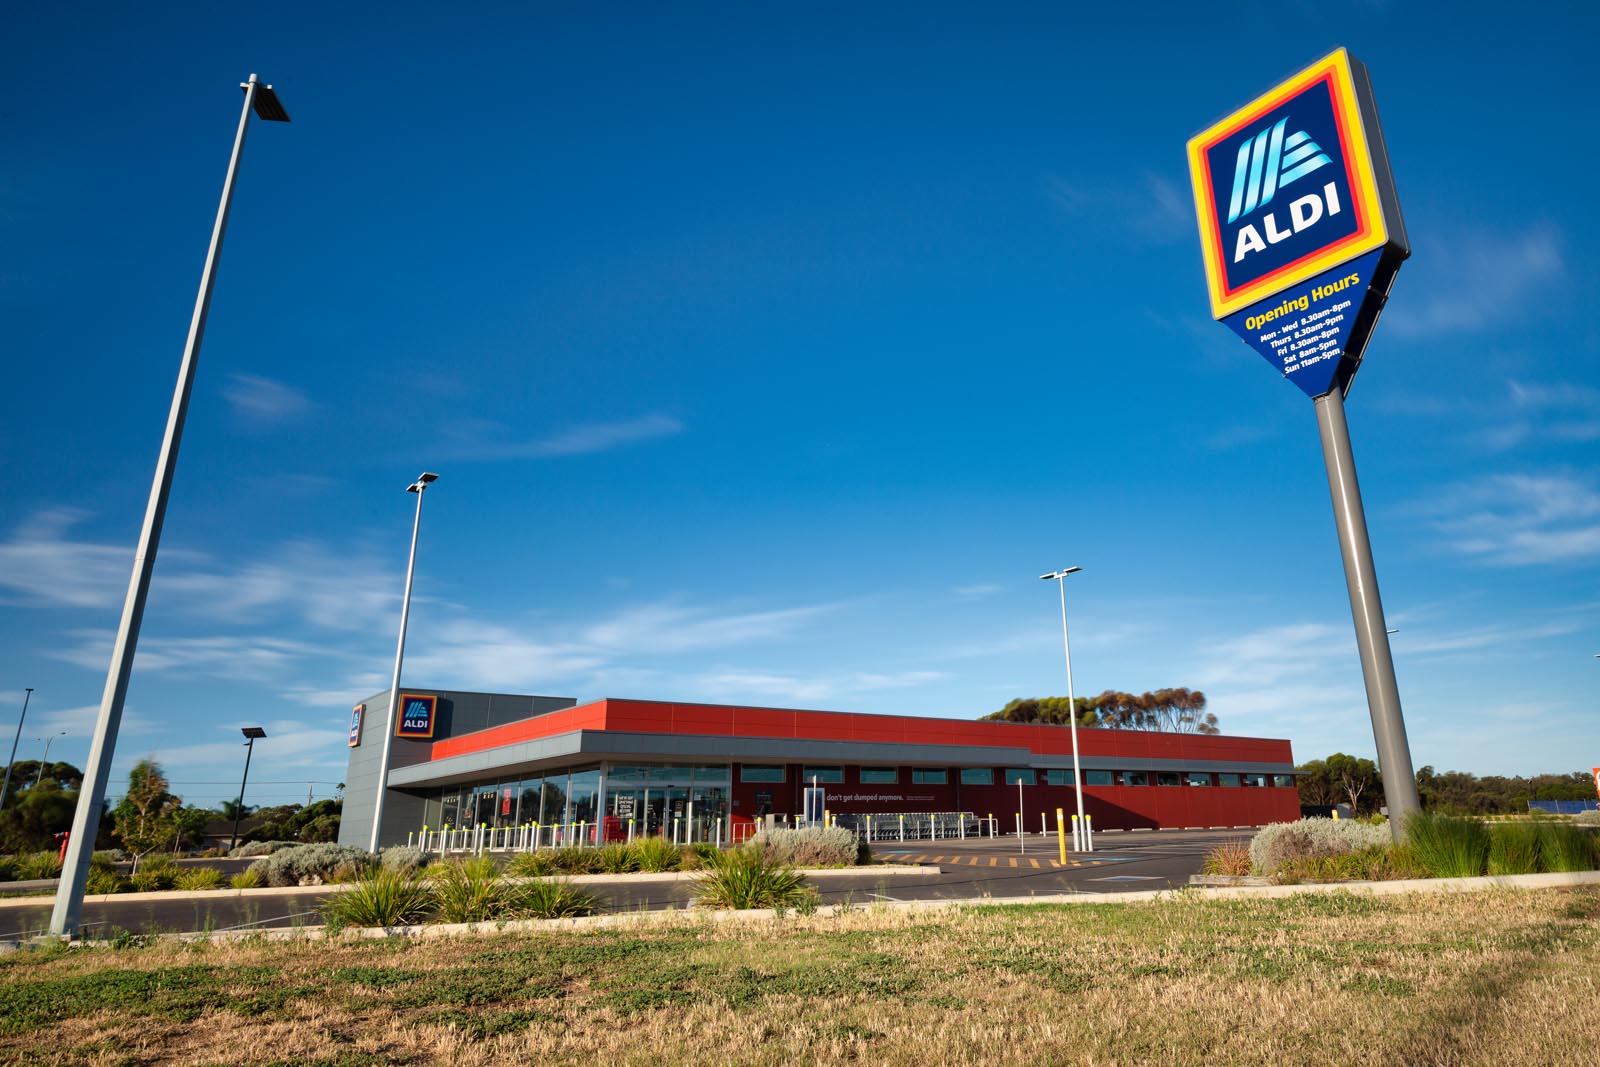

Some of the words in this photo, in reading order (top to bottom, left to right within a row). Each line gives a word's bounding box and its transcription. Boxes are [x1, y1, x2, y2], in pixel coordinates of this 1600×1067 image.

[1234, 181, 1341, 264] ALDI
[1245, 295, 1309, 330] Opening
[1311, 272, 1360, 302] Hours
[1260, 331, 1277, 342] Mon
[1281, 321, 1298, 333] Wed
[1300, 300, 1351, 326] 8.30am-8pm
[1270, 335, 1292, 348] Thurs
[1294, 314, 1344, 339] 8.30am-9pm
[1277, 348, 1288, 357] Fri
[1290, 326, 1340, 351] 8.30am-8pm
[1283, 354, 1297, 364] Sat
[1299, 338, 1337, 359] 8am-5pm
[1284, 363, 1300, 374] Sun
[1300, 347, 1340, 367] 11am-5pm
[403, 719, 428, 728] ALDI
[843, 795, 853, 803] get
[853, 793, 878, 803] dumped
